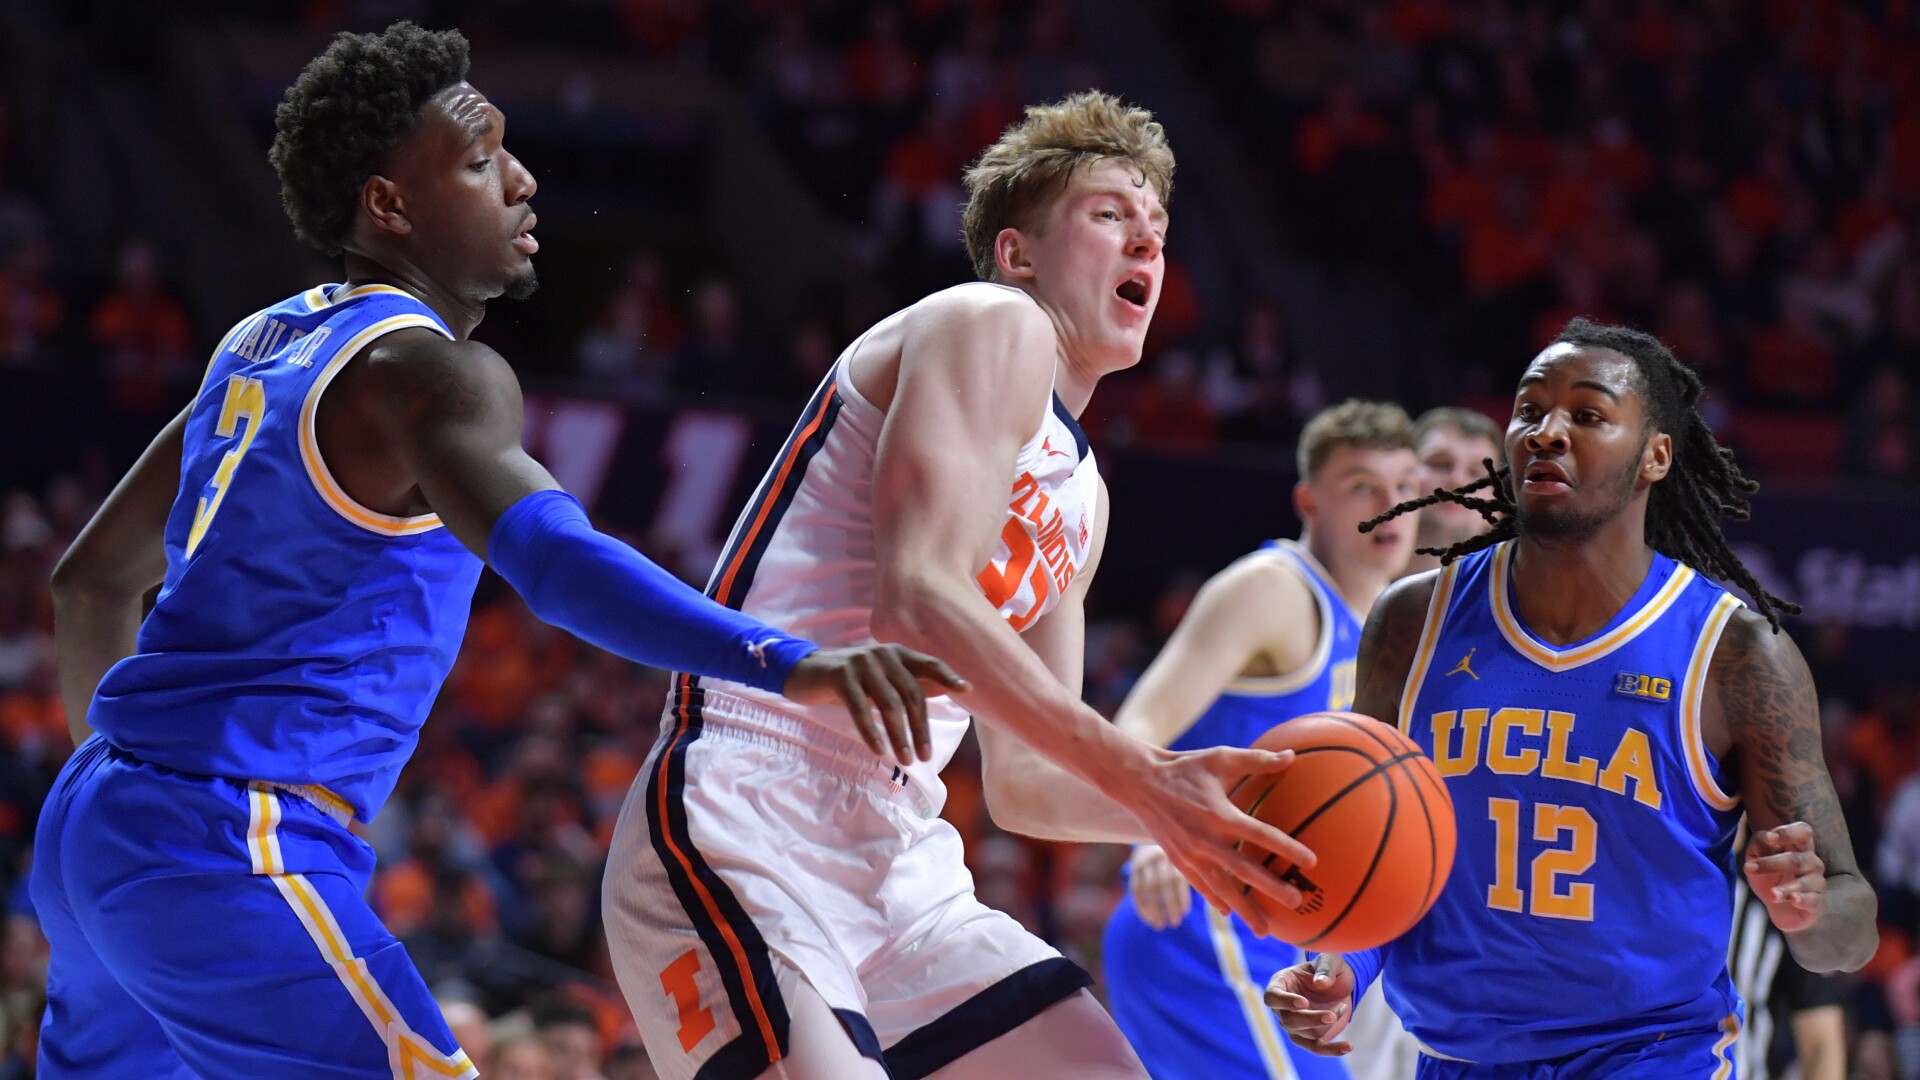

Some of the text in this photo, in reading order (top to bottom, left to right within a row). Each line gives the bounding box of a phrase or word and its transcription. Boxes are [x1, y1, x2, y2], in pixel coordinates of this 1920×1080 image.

[186, 374, 265, 558] 3
[1431, 707, 1661, 810] UCLA
[1487, 797, 1598, 921] 12
